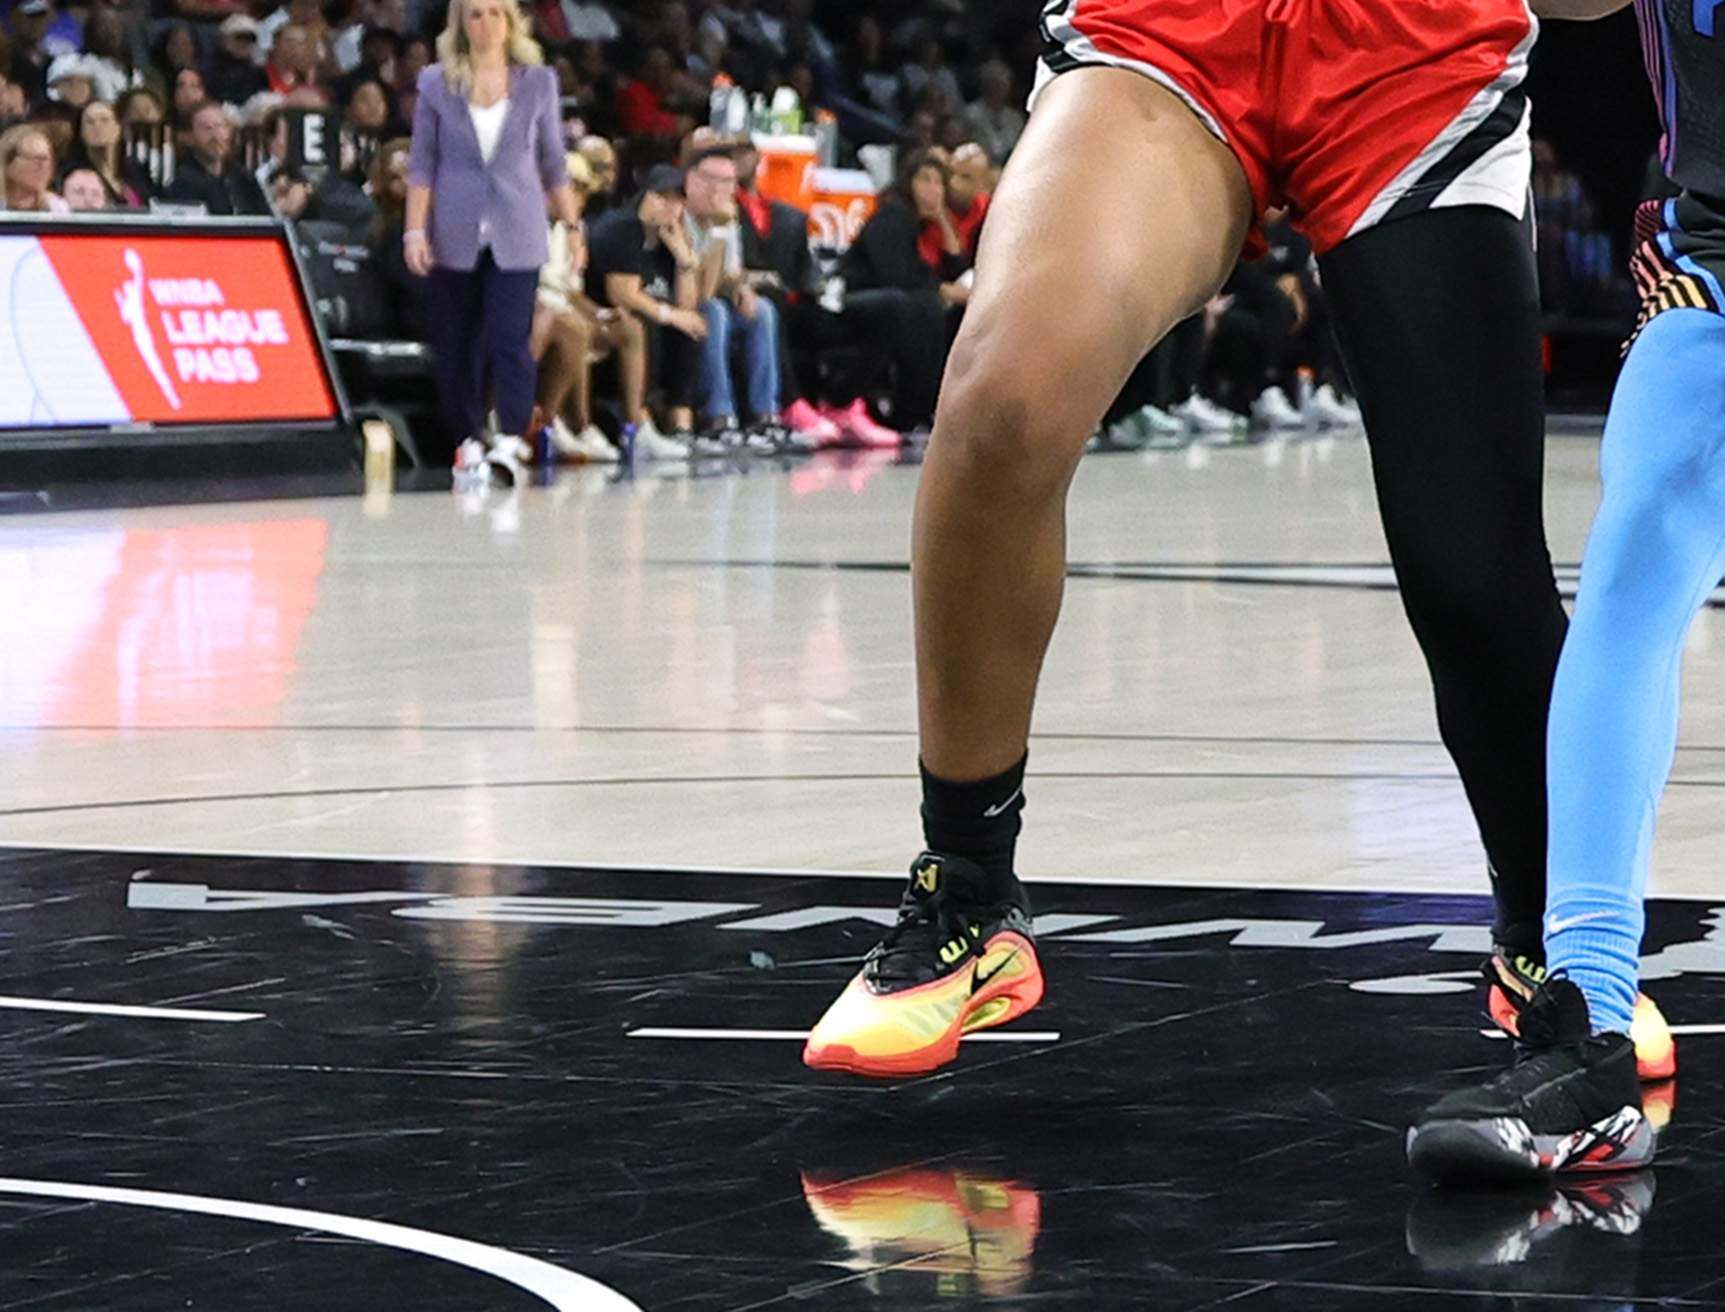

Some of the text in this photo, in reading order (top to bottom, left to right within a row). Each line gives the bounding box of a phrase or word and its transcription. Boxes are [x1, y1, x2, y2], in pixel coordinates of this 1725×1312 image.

[303, 112, 326, 164] E
[149, 277, 226, 307] WNBA
[161, 309, 290, 345] LEAGUE
[172, 347, 259, 383] PASS
